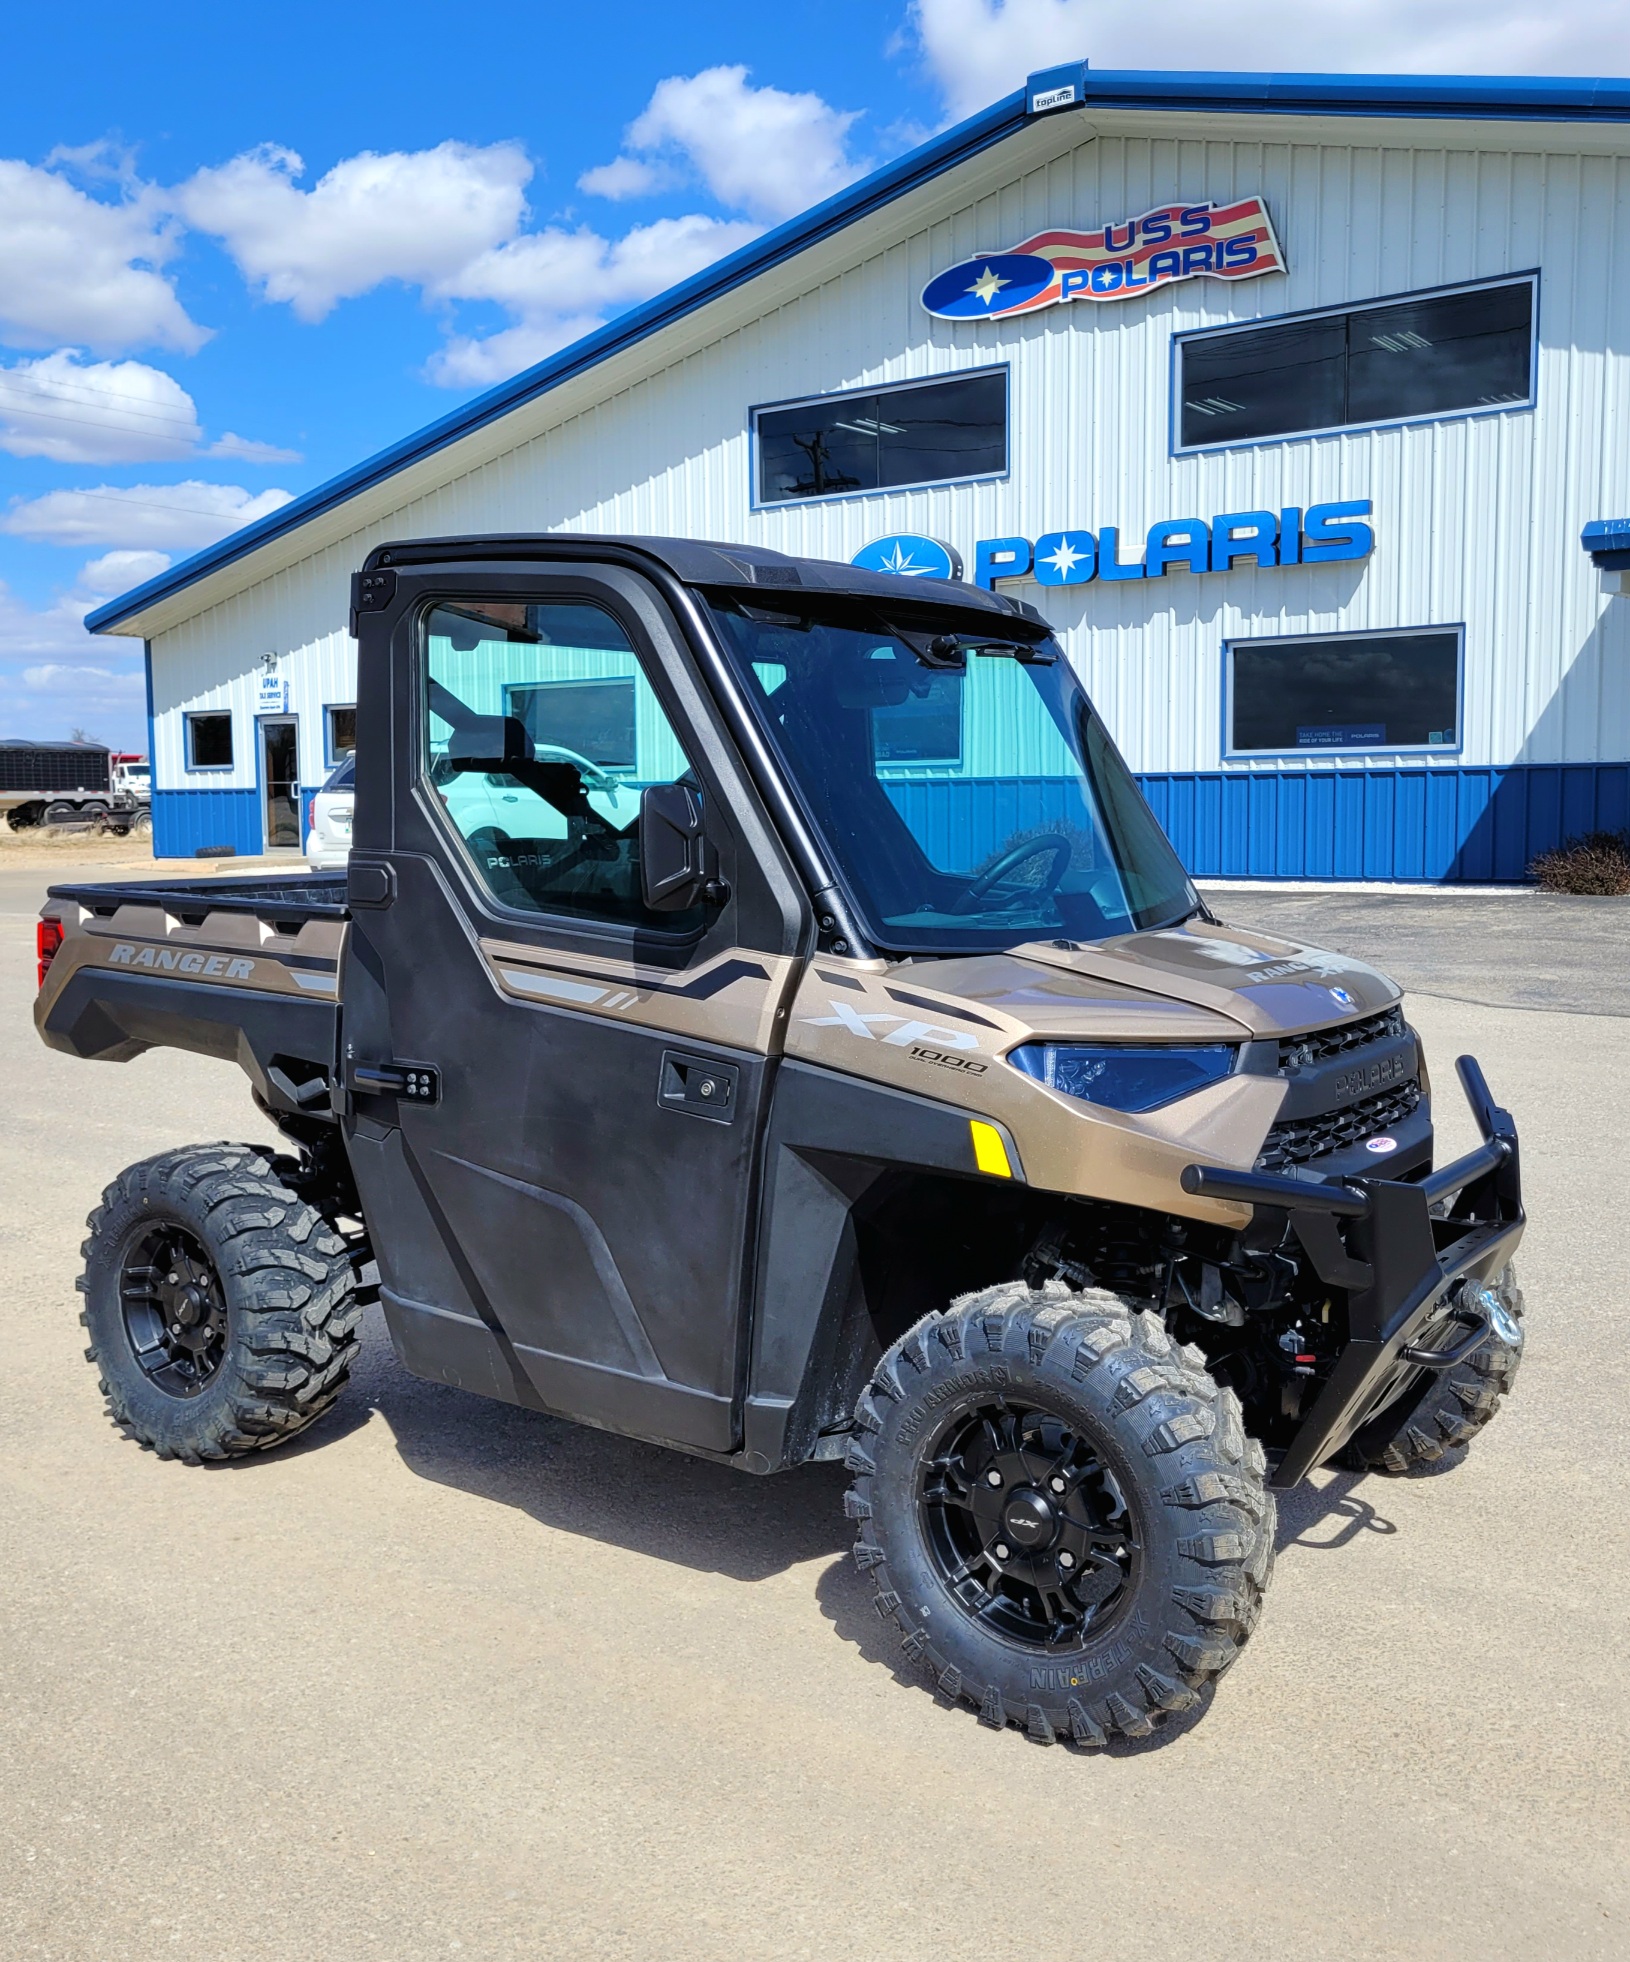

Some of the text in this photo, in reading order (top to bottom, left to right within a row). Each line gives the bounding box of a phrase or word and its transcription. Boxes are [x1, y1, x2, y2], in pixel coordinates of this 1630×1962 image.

[1104, 204, 1211, 253] USS
[1061, 235, 1258, 299] POLARIS
[975, 499, 1373, 591] POLARIS
[487, 854, 551, 869] POLARIS
[108, 943, 255, 980] RANGER
[1313, 963, 1349, 979] XP
[797, 1000, 982, 1050] XP
[908, 1055, 927, 1063] DUAL
[928, 1061, 966, 1074] OVERHEAD
[910, 1046, 989, 1073] 1000
[1335, 1055, 1404, 1101] POLARIS
[895, 1369, 992, 1446] PRO ARMOR
[1010, 1518, 1039, 1528] XP
[1030, 1609, 1150, 1691] X-TERRAIN
